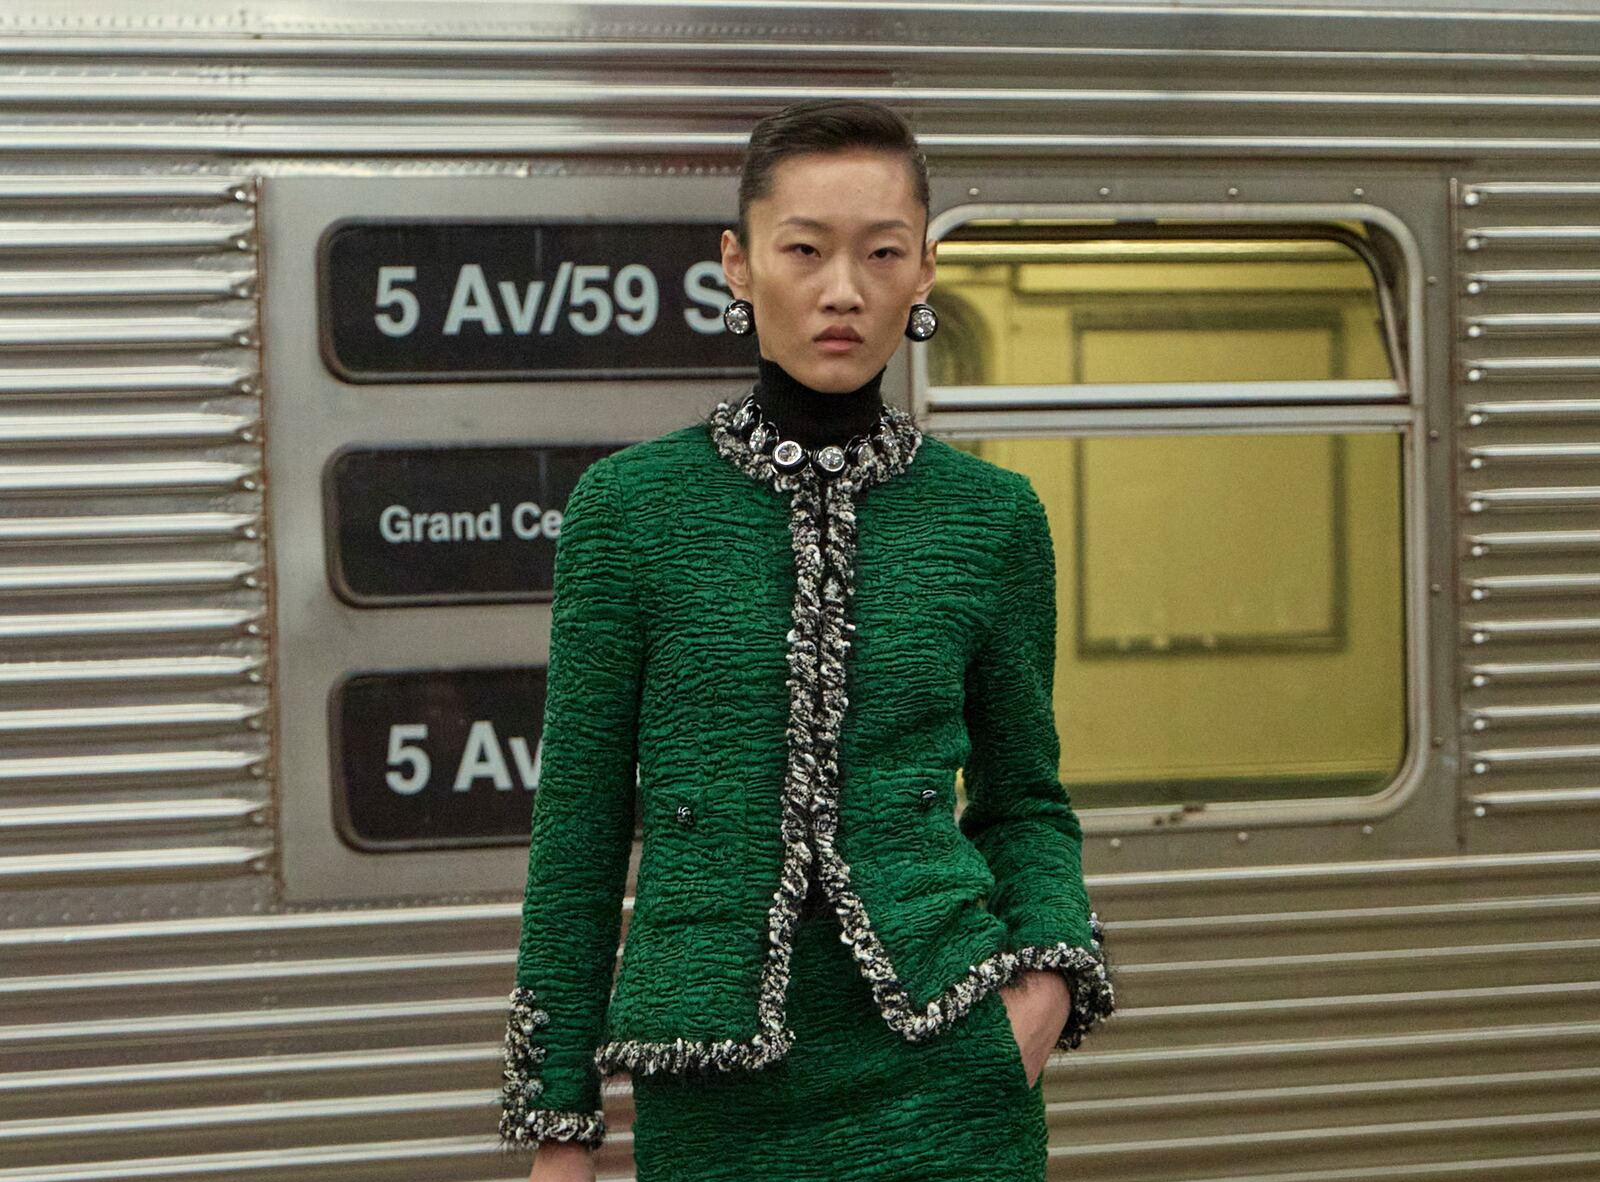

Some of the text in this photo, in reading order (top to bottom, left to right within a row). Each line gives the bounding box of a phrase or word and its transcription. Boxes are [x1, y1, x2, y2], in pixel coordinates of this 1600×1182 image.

[373, 265, 421, 339] 5
[441, 261, 660, 337] Av/59
[378, 502, 502, 544] Grand
[384, 723, 432, 796] 5
